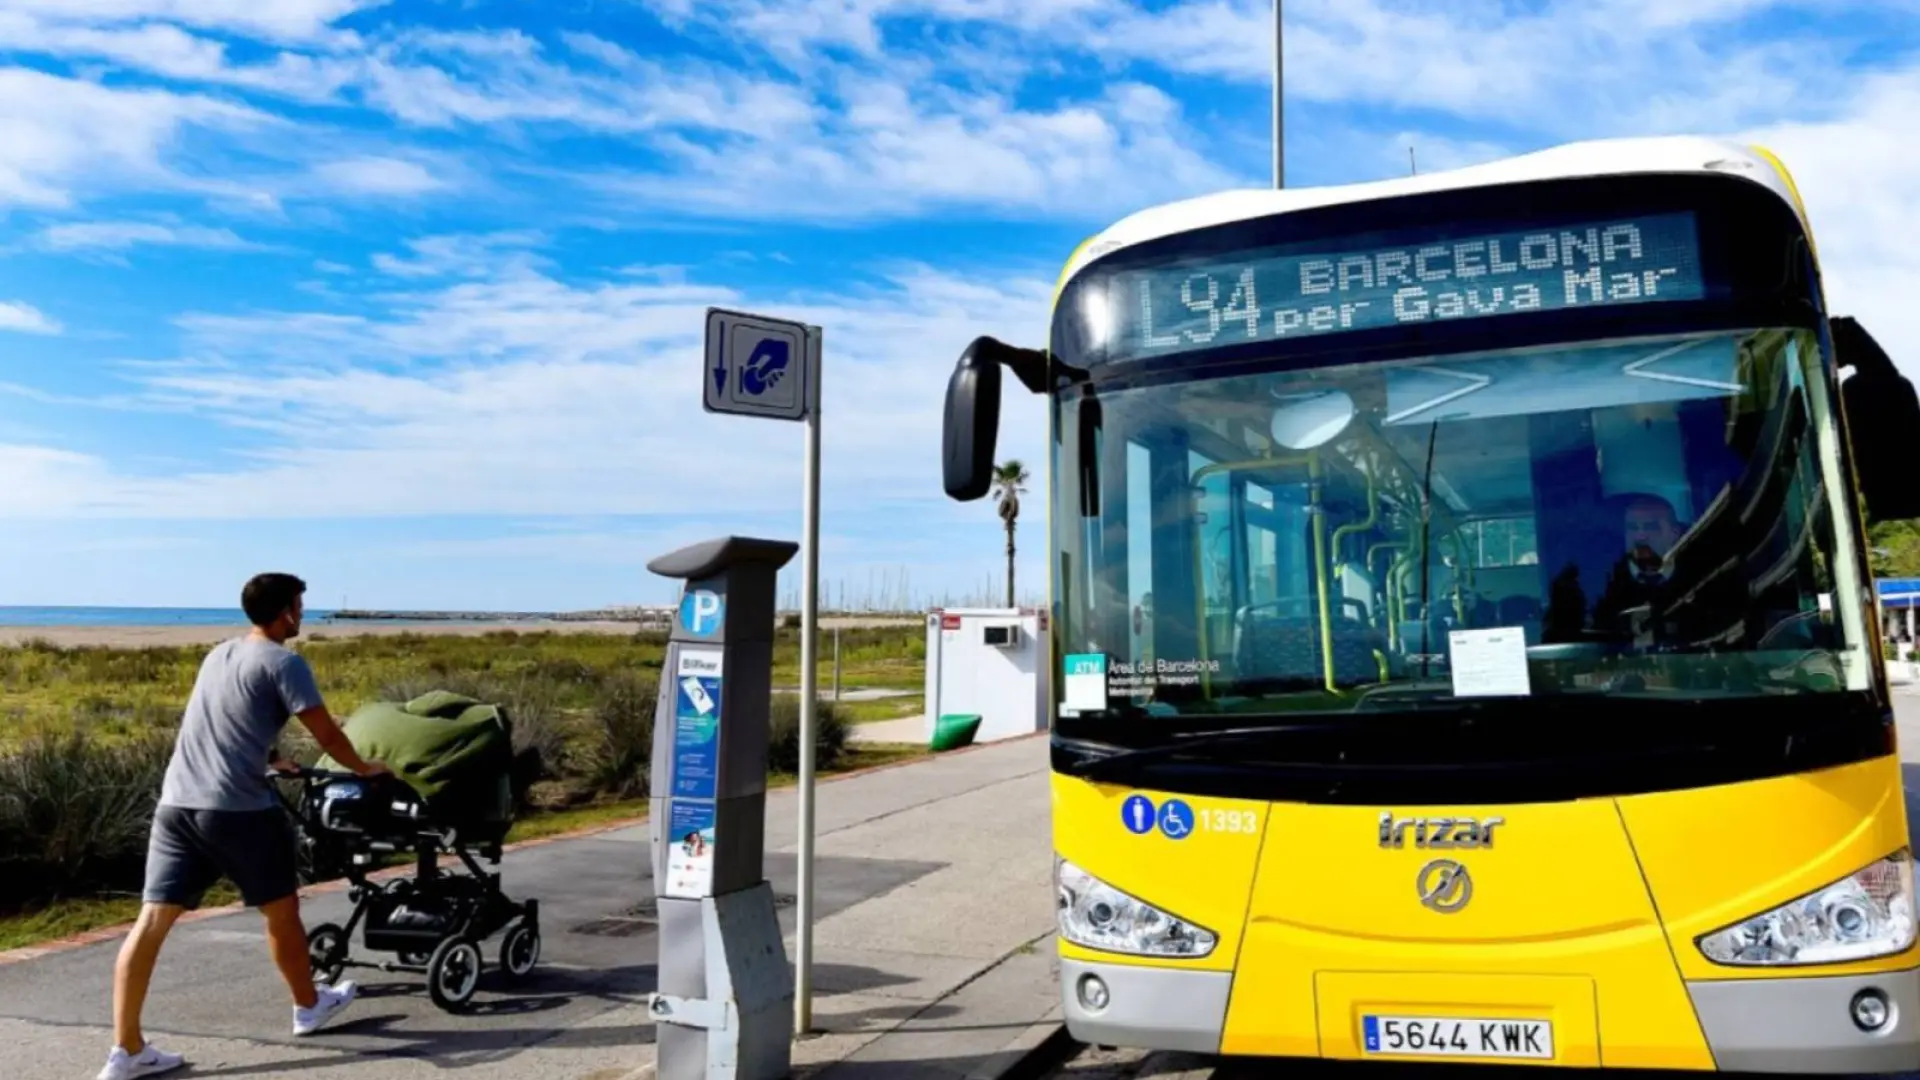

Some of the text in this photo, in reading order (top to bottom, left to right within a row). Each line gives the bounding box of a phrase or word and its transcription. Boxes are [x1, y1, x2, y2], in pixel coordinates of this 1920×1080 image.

[1300, 224, 1643, 295] BARCELONA
[1140, 267, 1260, 348] L94
[1274, 266, 1678, 335] per Gava Mar
[692, 590, 719, 632] P
[1075, 661, 1101, 674] ATM
[1138, 659, 1154, 673] de
[1157, 657, 1220, 673] Barcelona
[1200, 809, 1257, 833] 1393
[1379, 811, 1505, 849] irizar
[1385, 1020, 1468, 1050] 5644
[1480, 1023, 1542, 1053] KWK
